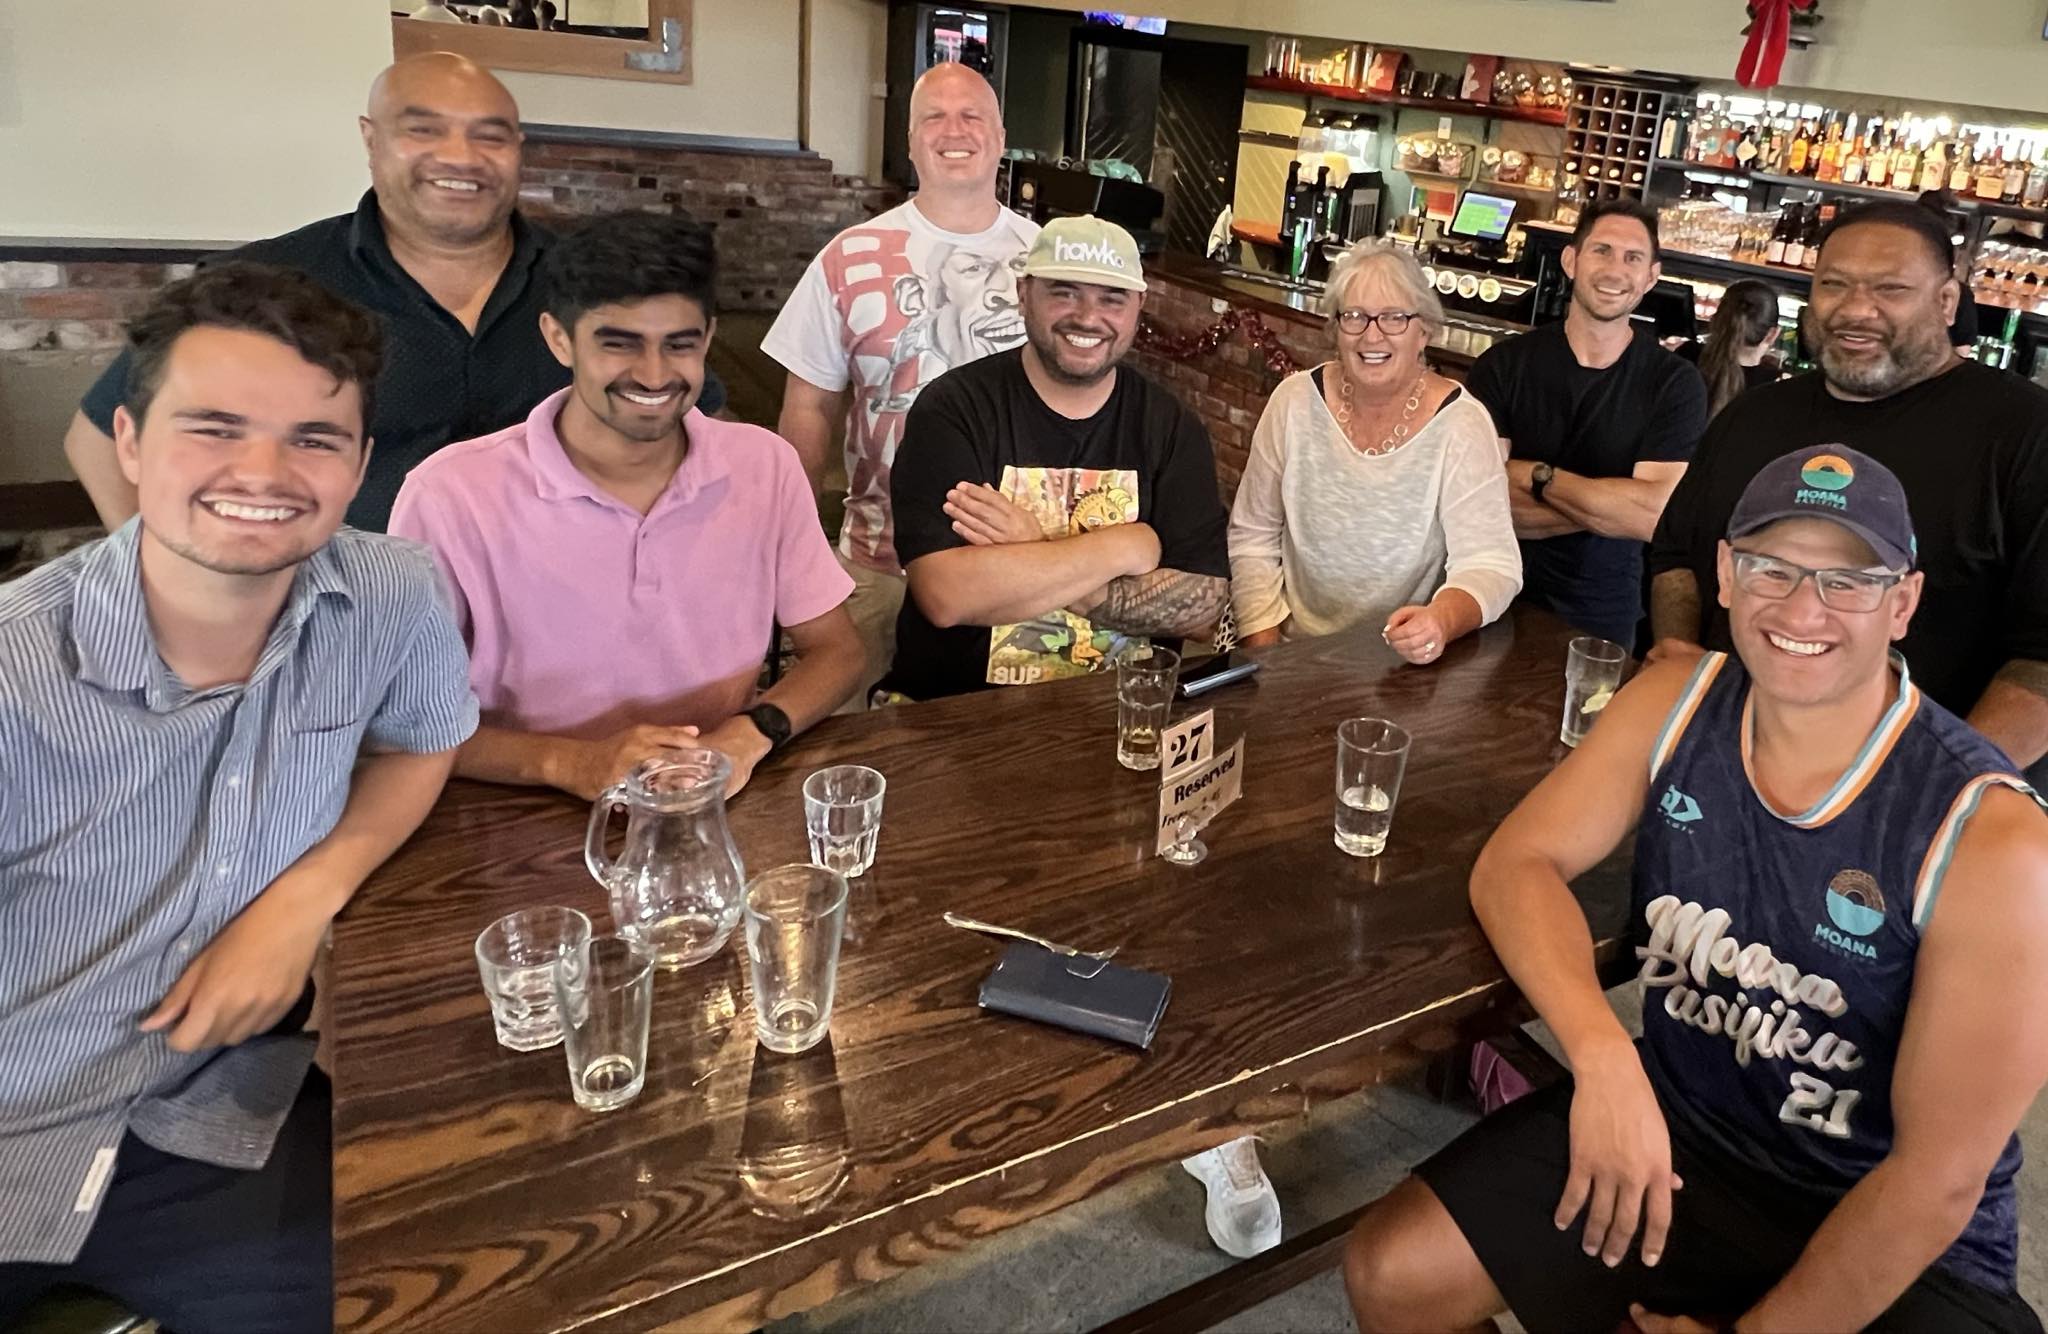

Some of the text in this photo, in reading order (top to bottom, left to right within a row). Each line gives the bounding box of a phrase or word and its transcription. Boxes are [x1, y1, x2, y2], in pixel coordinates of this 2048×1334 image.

[1796, 489, 1847, 504] MOANA
[1170, 722, 1207, 768] 27
[1174, 751, 1236, 805] Reserved
[1645, 894, 1849, 1018] Moana
[1814, 922, 1878, 960] MOANA
[1635, 945, 1864, 1069] Pasifika
[1778, 1071, 1862, 1138] 21
